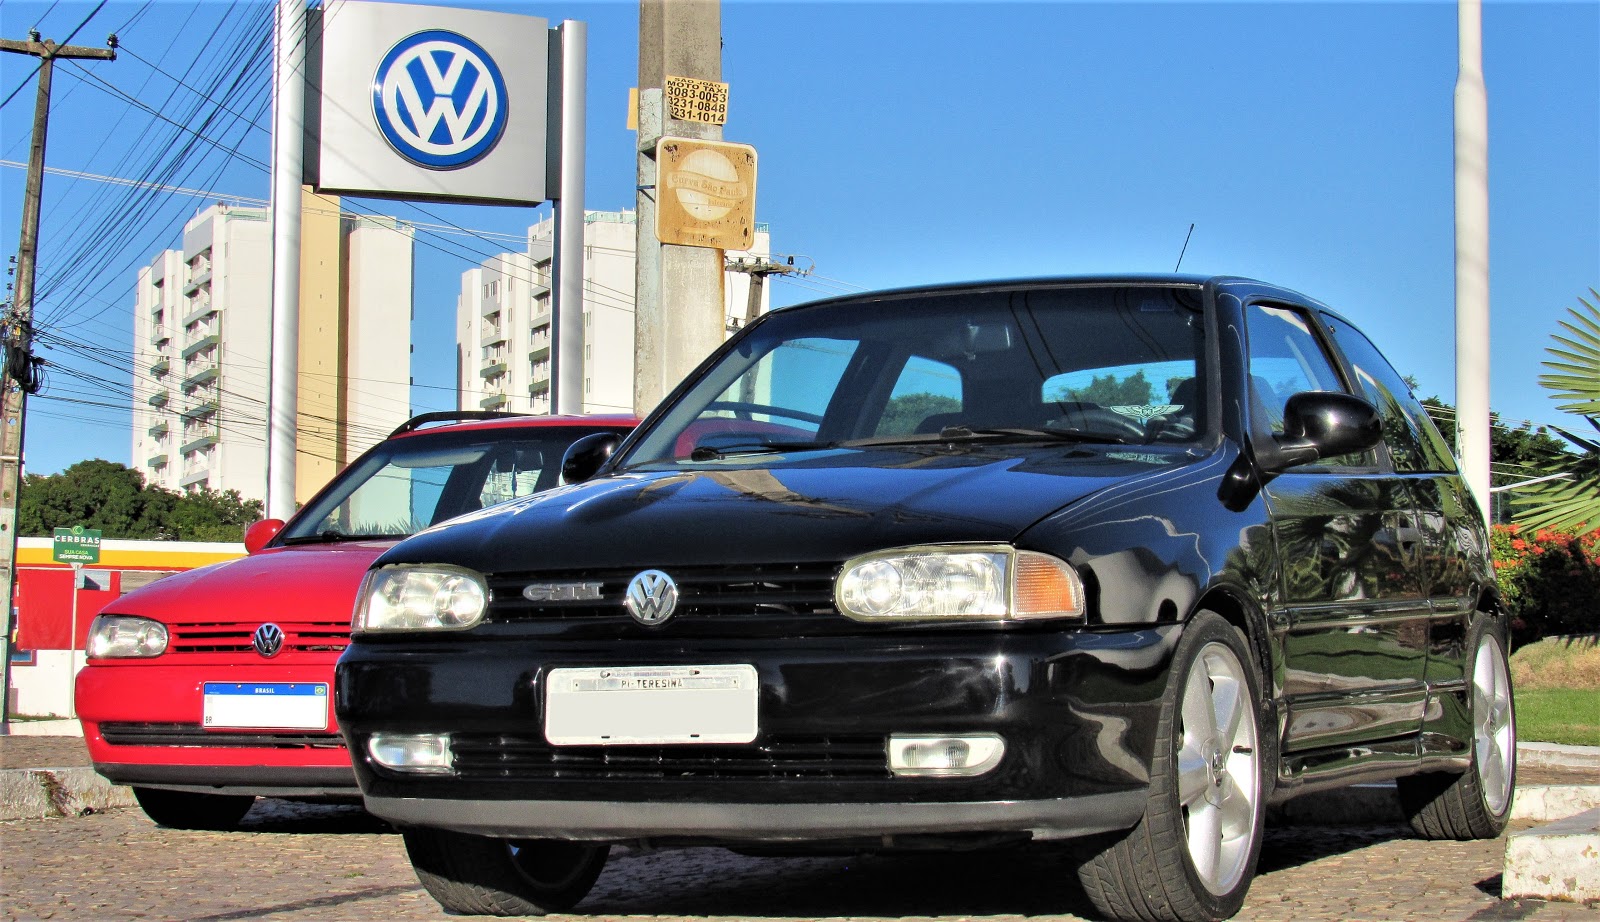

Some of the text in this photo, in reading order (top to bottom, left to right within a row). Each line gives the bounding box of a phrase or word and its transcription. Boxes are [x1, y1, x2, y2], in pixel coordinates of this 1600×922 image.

[667, 80, 728, 94] MOTO TAXI
[667, 85, 727, 103] 3083-0053
[380, 40, 498, 156] VW
[668, 95, 726, 113] 3231-0848
[672, 174, 699, 187] Curva
[55, 535, 100, 544] CERBRAS
[626, 569, 679, 626] VW
[254, 622, 284, 658] VW
